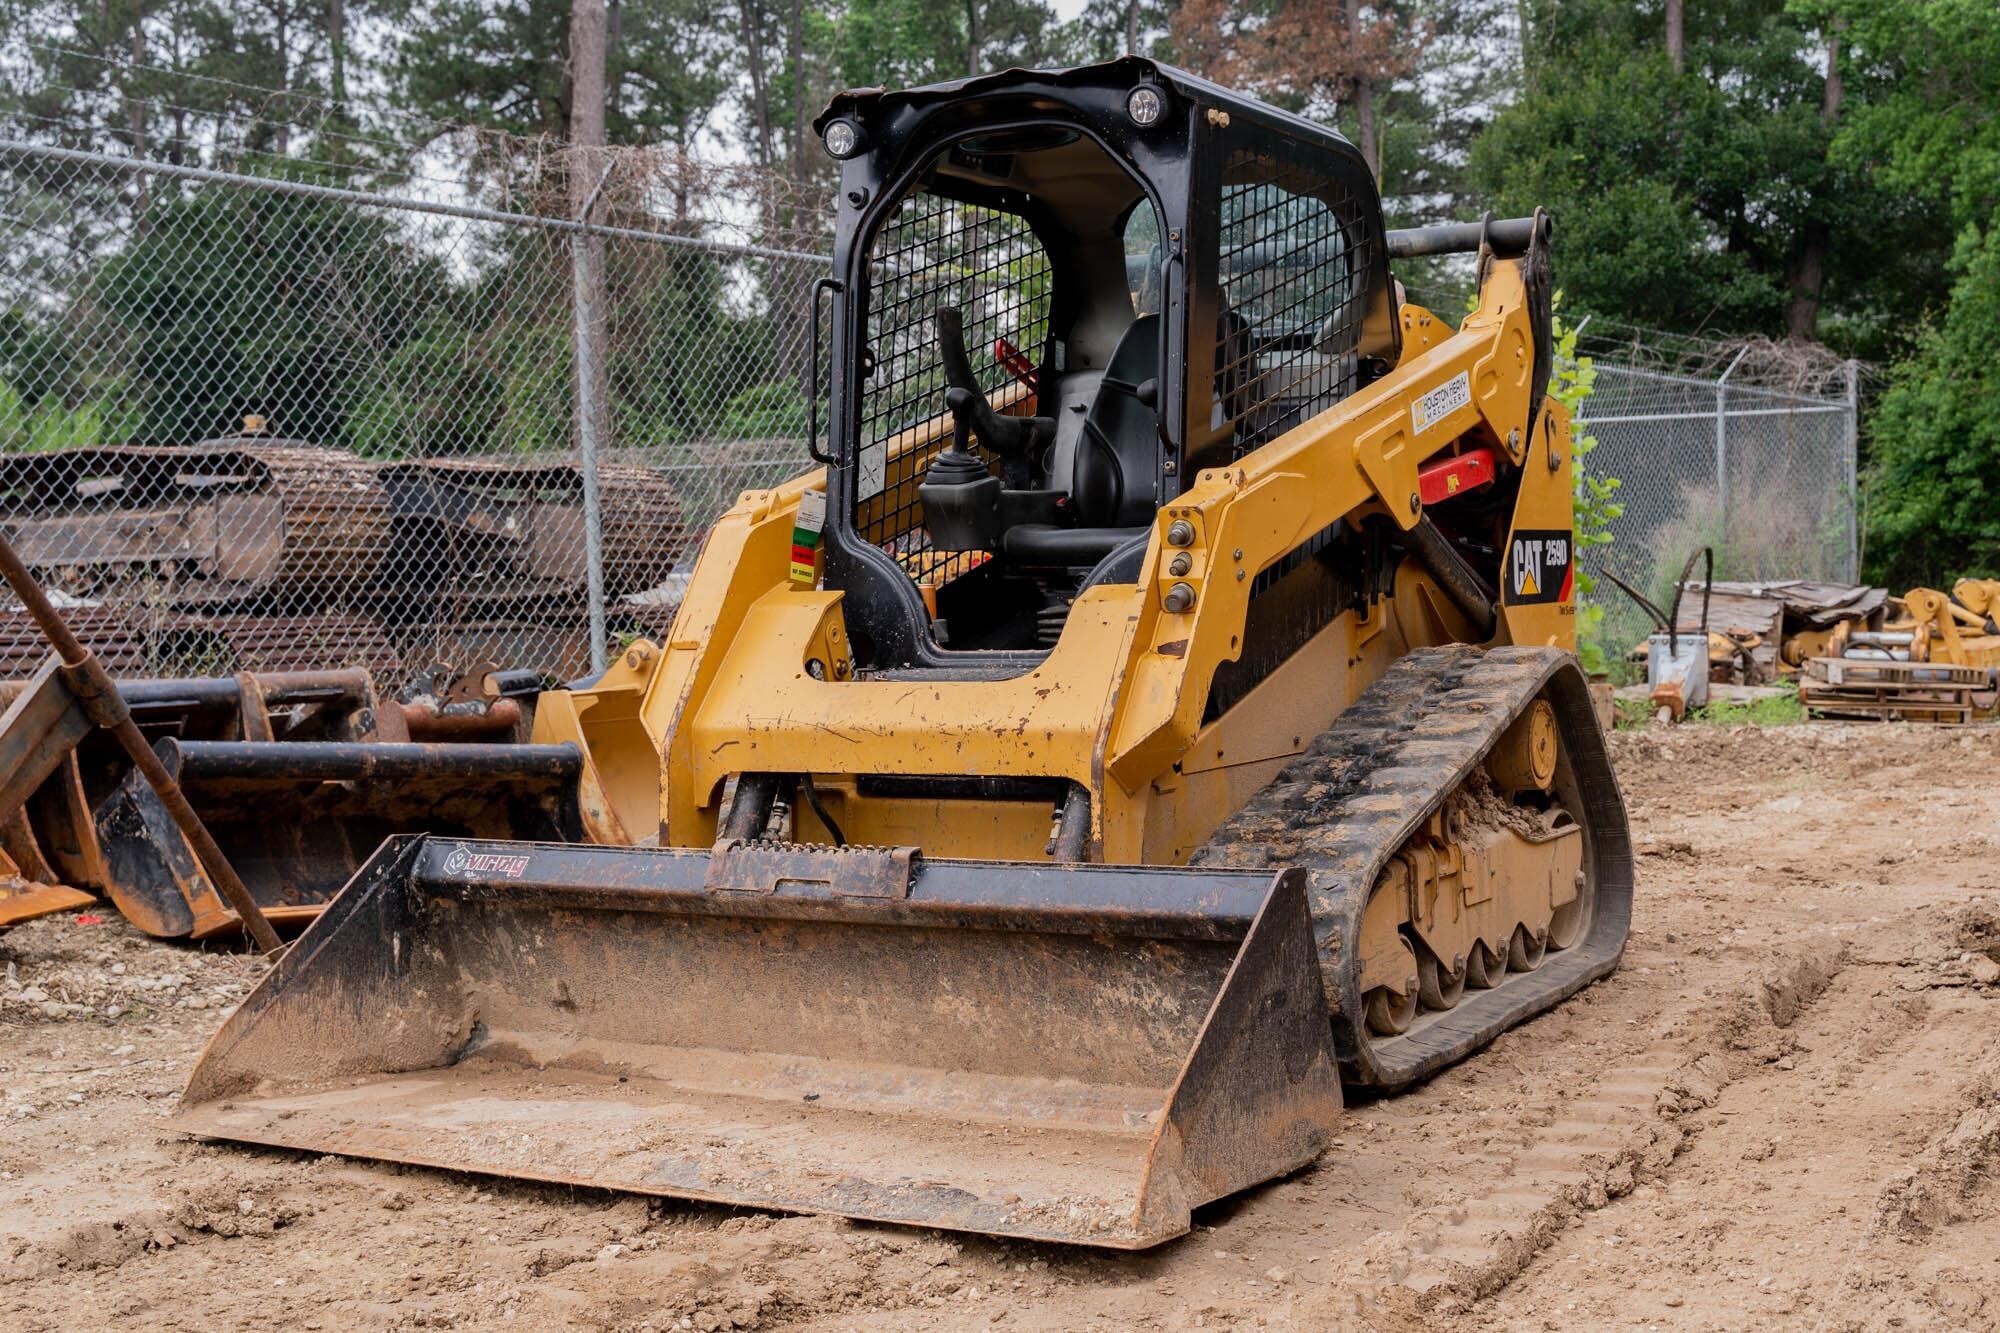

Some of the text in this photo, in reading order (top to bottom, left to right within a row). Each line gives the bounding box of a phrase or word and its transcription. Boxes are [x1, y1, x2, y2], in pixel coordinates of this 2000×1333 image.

[1423, 387, 1449, 411] HOUSTON
[1513, 539, 1567, 595] CAT 259D
